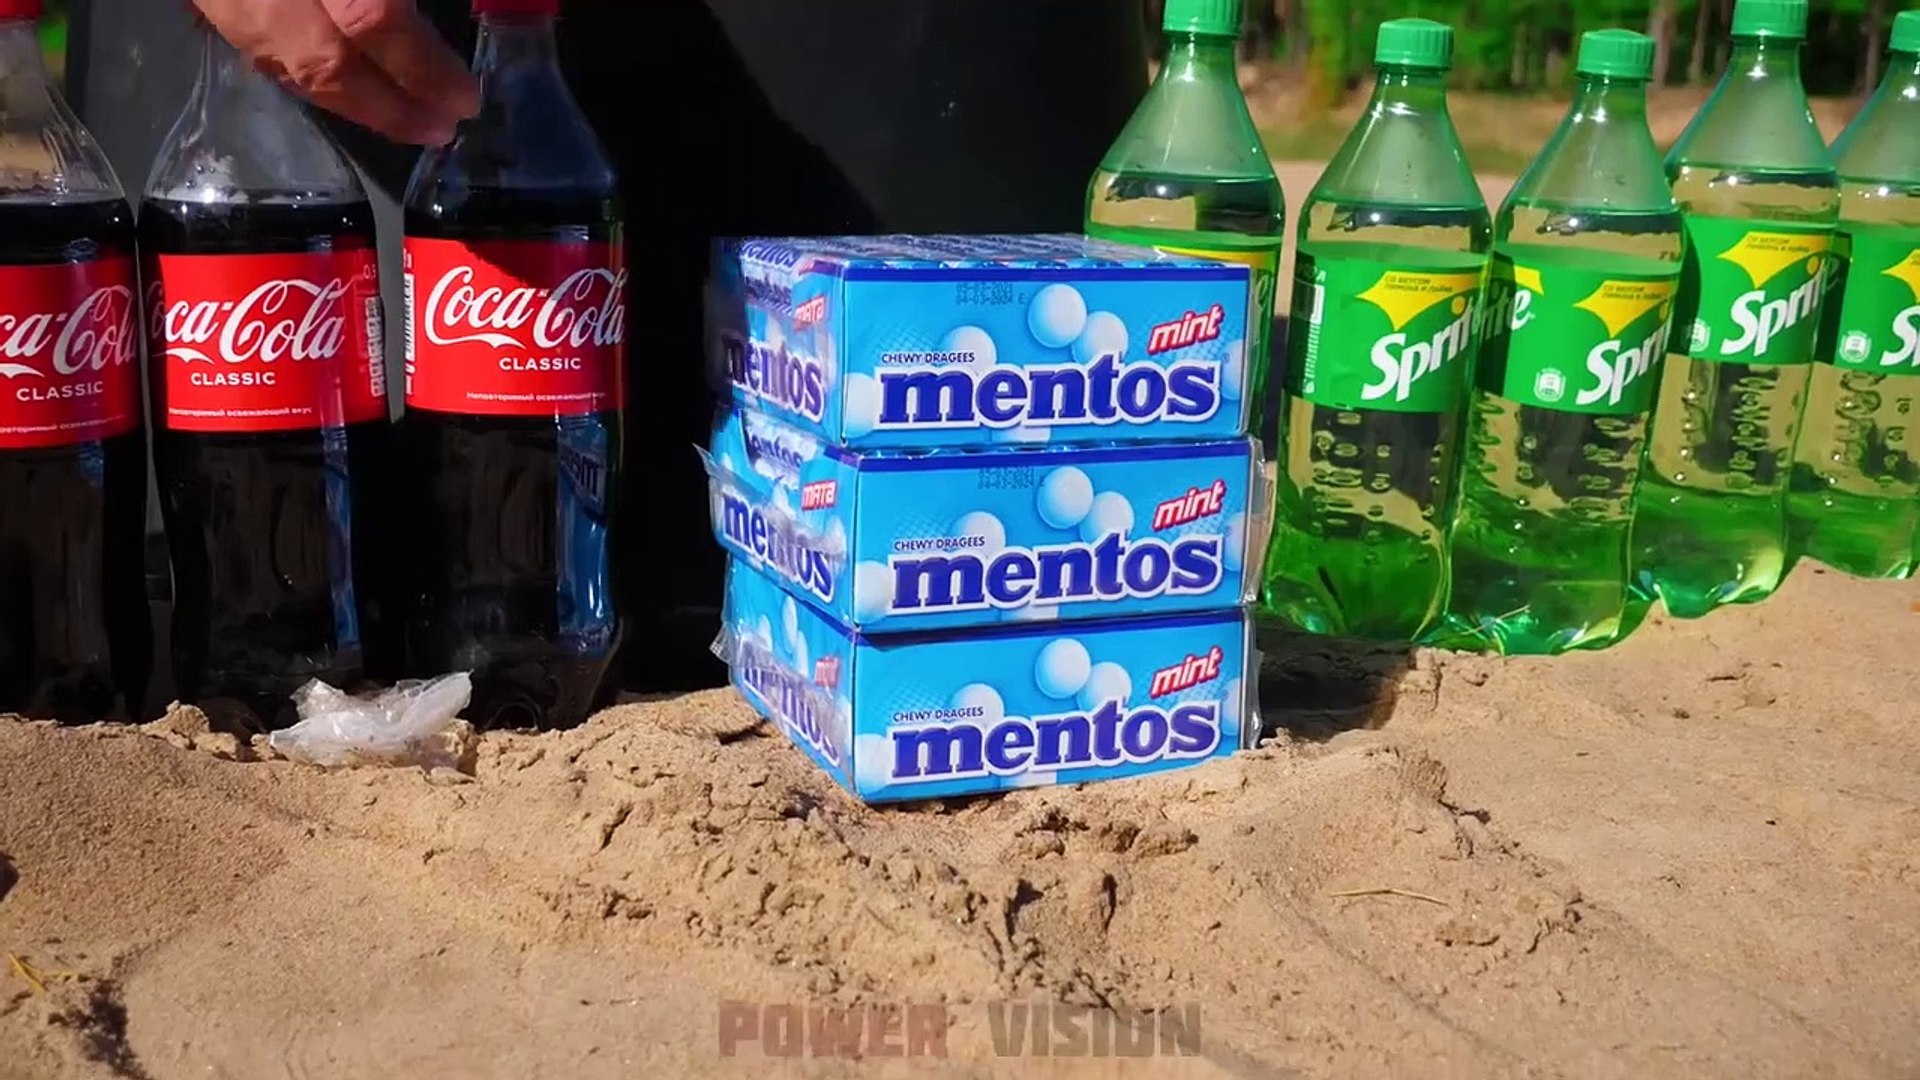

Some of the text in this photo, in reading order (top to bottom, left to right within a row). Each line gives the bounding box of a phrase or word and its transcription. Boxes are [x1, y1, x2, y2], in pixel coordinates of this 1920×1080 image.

[424, 266, 627, 350] Coca-Cola
[1149, 304, 1225, 352] mint
[190, 371, 277, 386] CLASSIC
[499, 357, 582, 371] CLASSIC
[881, 351, 976, 364] CHEWY DRAGEES
[16, 381, 104, 402] CLASSIC
[878, 353, 1217, 425] mentos
[1155, 481, 1226, 529] mint
[893, 535, 986, 551] CHEWY DRAGEES
[892, 532, 1218, 609] mentos
[1152, 647, 1224, 697] mint
[892, 706, 985, 723] CHEWY DRAGEES
[892, 699, 1218, 779] mentos
